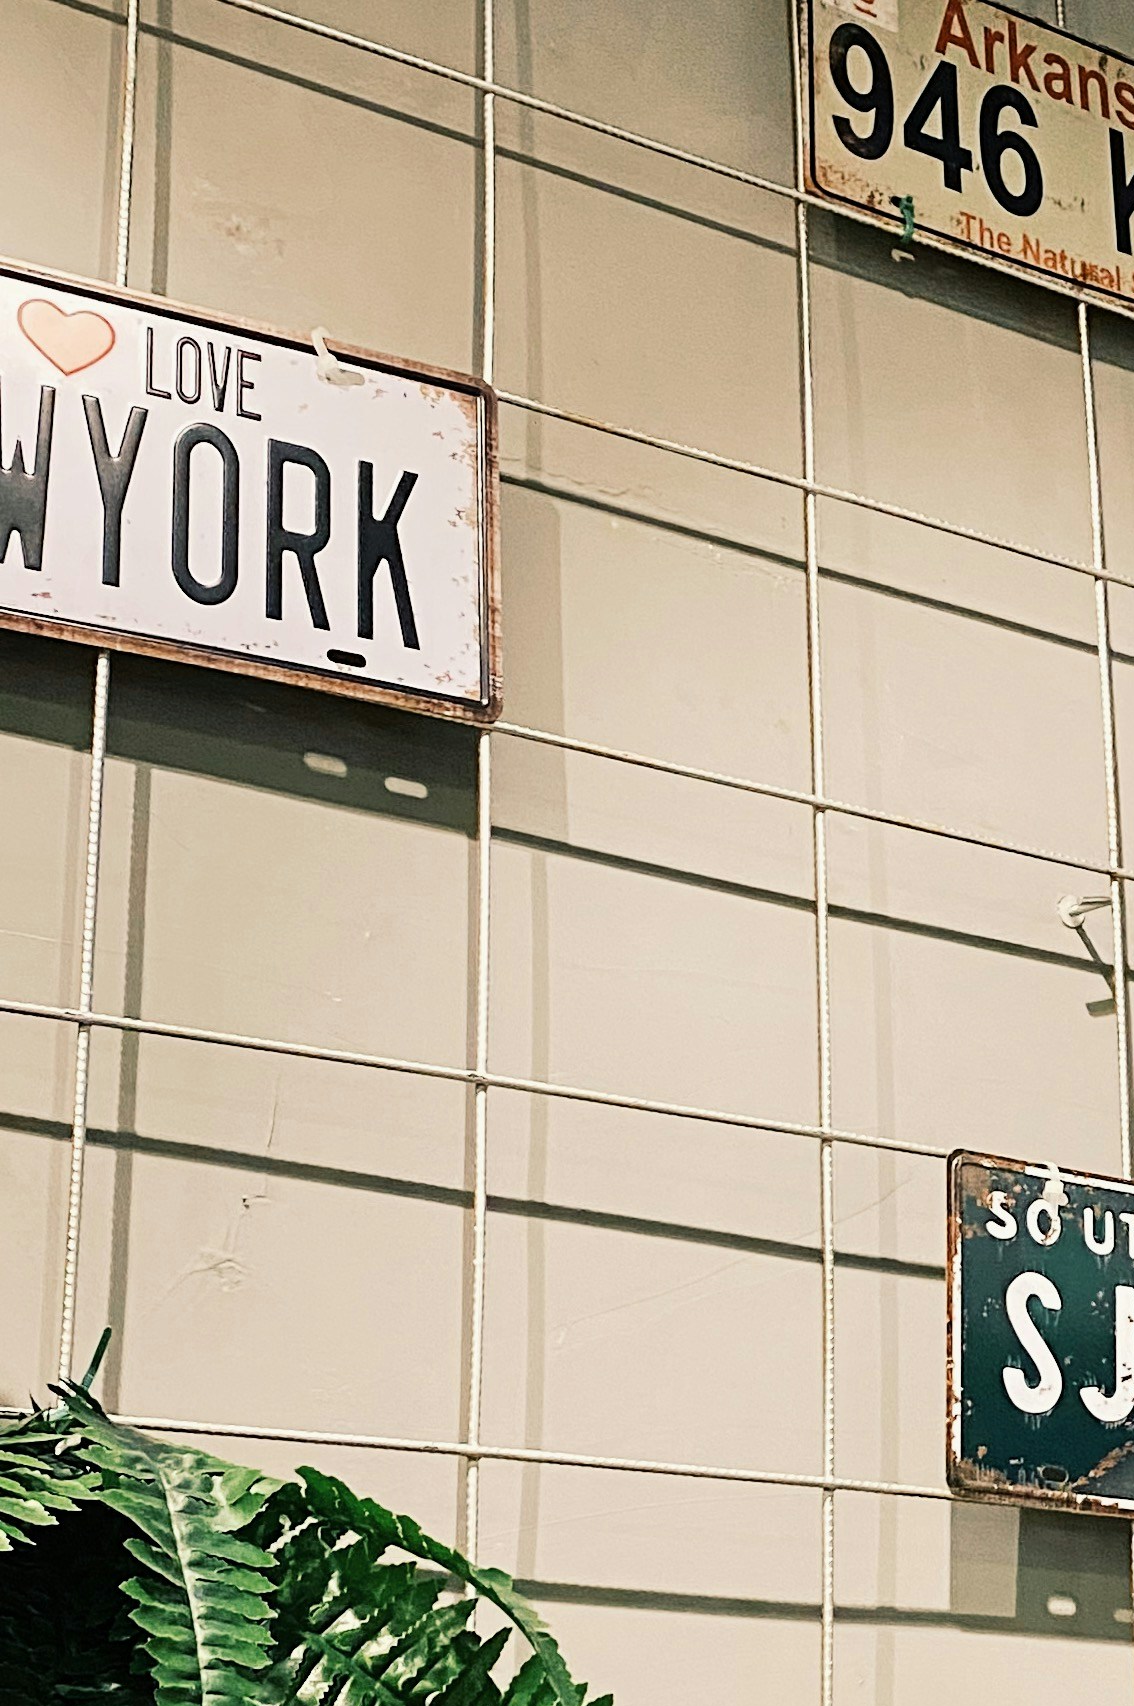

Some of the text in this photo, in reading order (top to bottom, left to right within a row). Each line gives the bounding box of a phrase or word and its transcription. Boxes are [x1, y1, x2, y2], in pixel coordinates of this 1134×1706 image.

[829, 22, 1044, 217] 946
[960, 211, 1012, 255] The
[1018, 234, 1122, 292] Natural
[146, 327, 262, 421] LOVE
